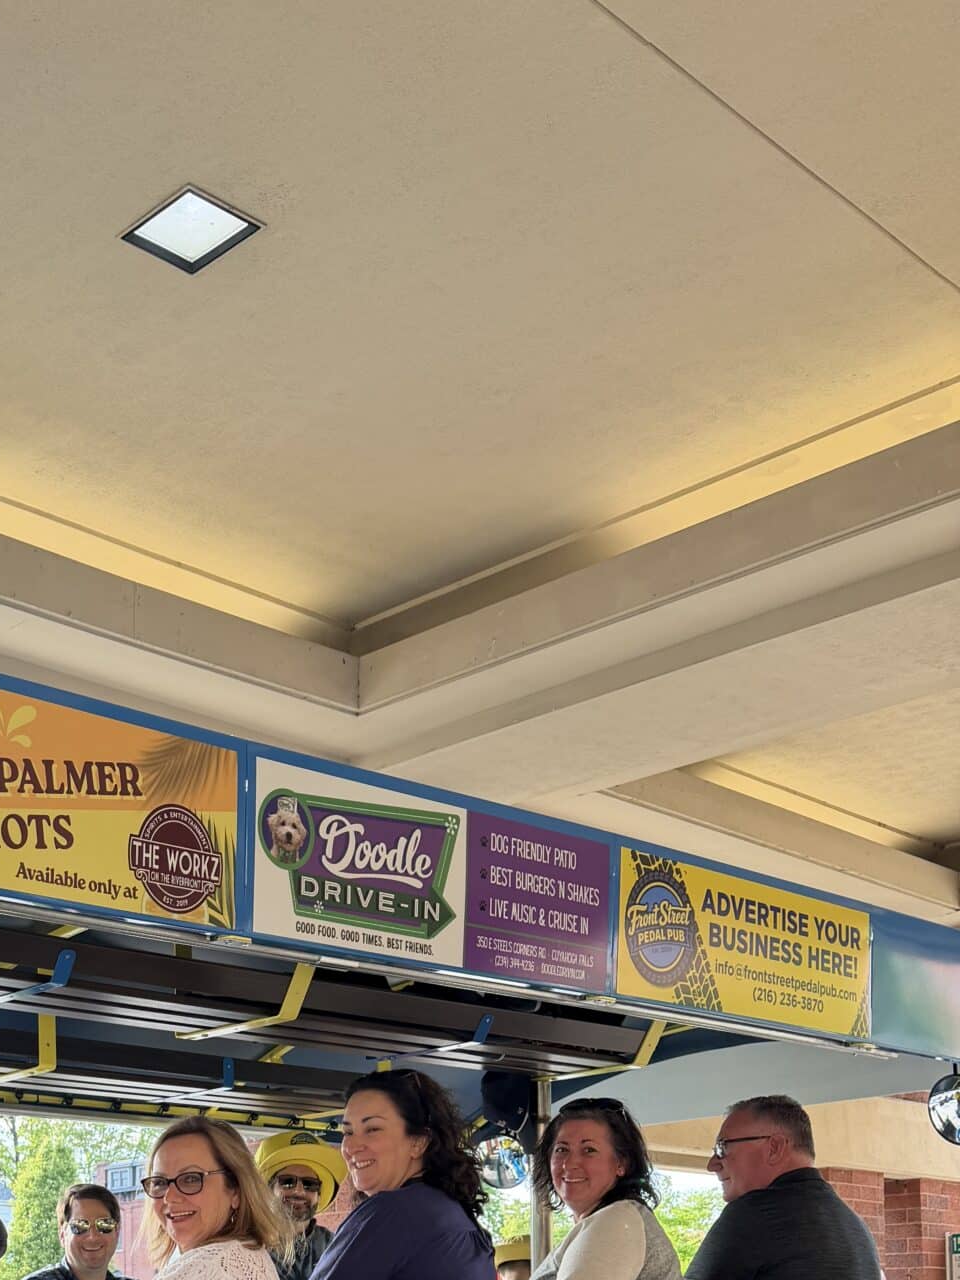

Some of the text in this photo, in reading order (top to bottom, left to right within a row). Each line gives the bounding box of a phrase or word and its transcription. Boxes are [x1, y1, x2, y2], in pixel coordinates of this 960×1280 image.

[145, 815, 162, 838] SPIRITS
[170, 812, 208, 849] ENTERTAINMENT
[133, 841, 219, 881] THE WORKZ
[319, 815, 432, 889] Doodle
[490, 832, 577, 870] DOG FRIENDLY PATIO
[16, 862, 138, 900] Available only at
[151, 871, 200, 887] ON THE RIVERFRONT
[490, 865, 513, 887] BEST
[515, 871, 555, 896] BURGERS
[567, 882, 600, 906] SHAKES
[300, 876, 440, 922] DRIVE-IN
[489, 897, 589, 935] LIVE MUSIC & CRUISE IN
[627, 901, 692, 935] Front Street
[638, 929, 685, 944] PEDAL PUB
[701, 888, 861, 950] ADVERTISE YOUR
[296, 921, 434, 956] GOOD FOOD. GOOD TIMES. BEST FRIENDS.
[493, 939, 512, 953] STEELS
[513, 942, 537, 957] CORNERS
[579, 953, 593, 967] FALLS
[709, 922, 858, 979] BUSINESS HERE!
[714, 958, 857, 1002] info@frontstreetpedalpub.com
[752, 987, 824, 1013] (216) 236-3870
